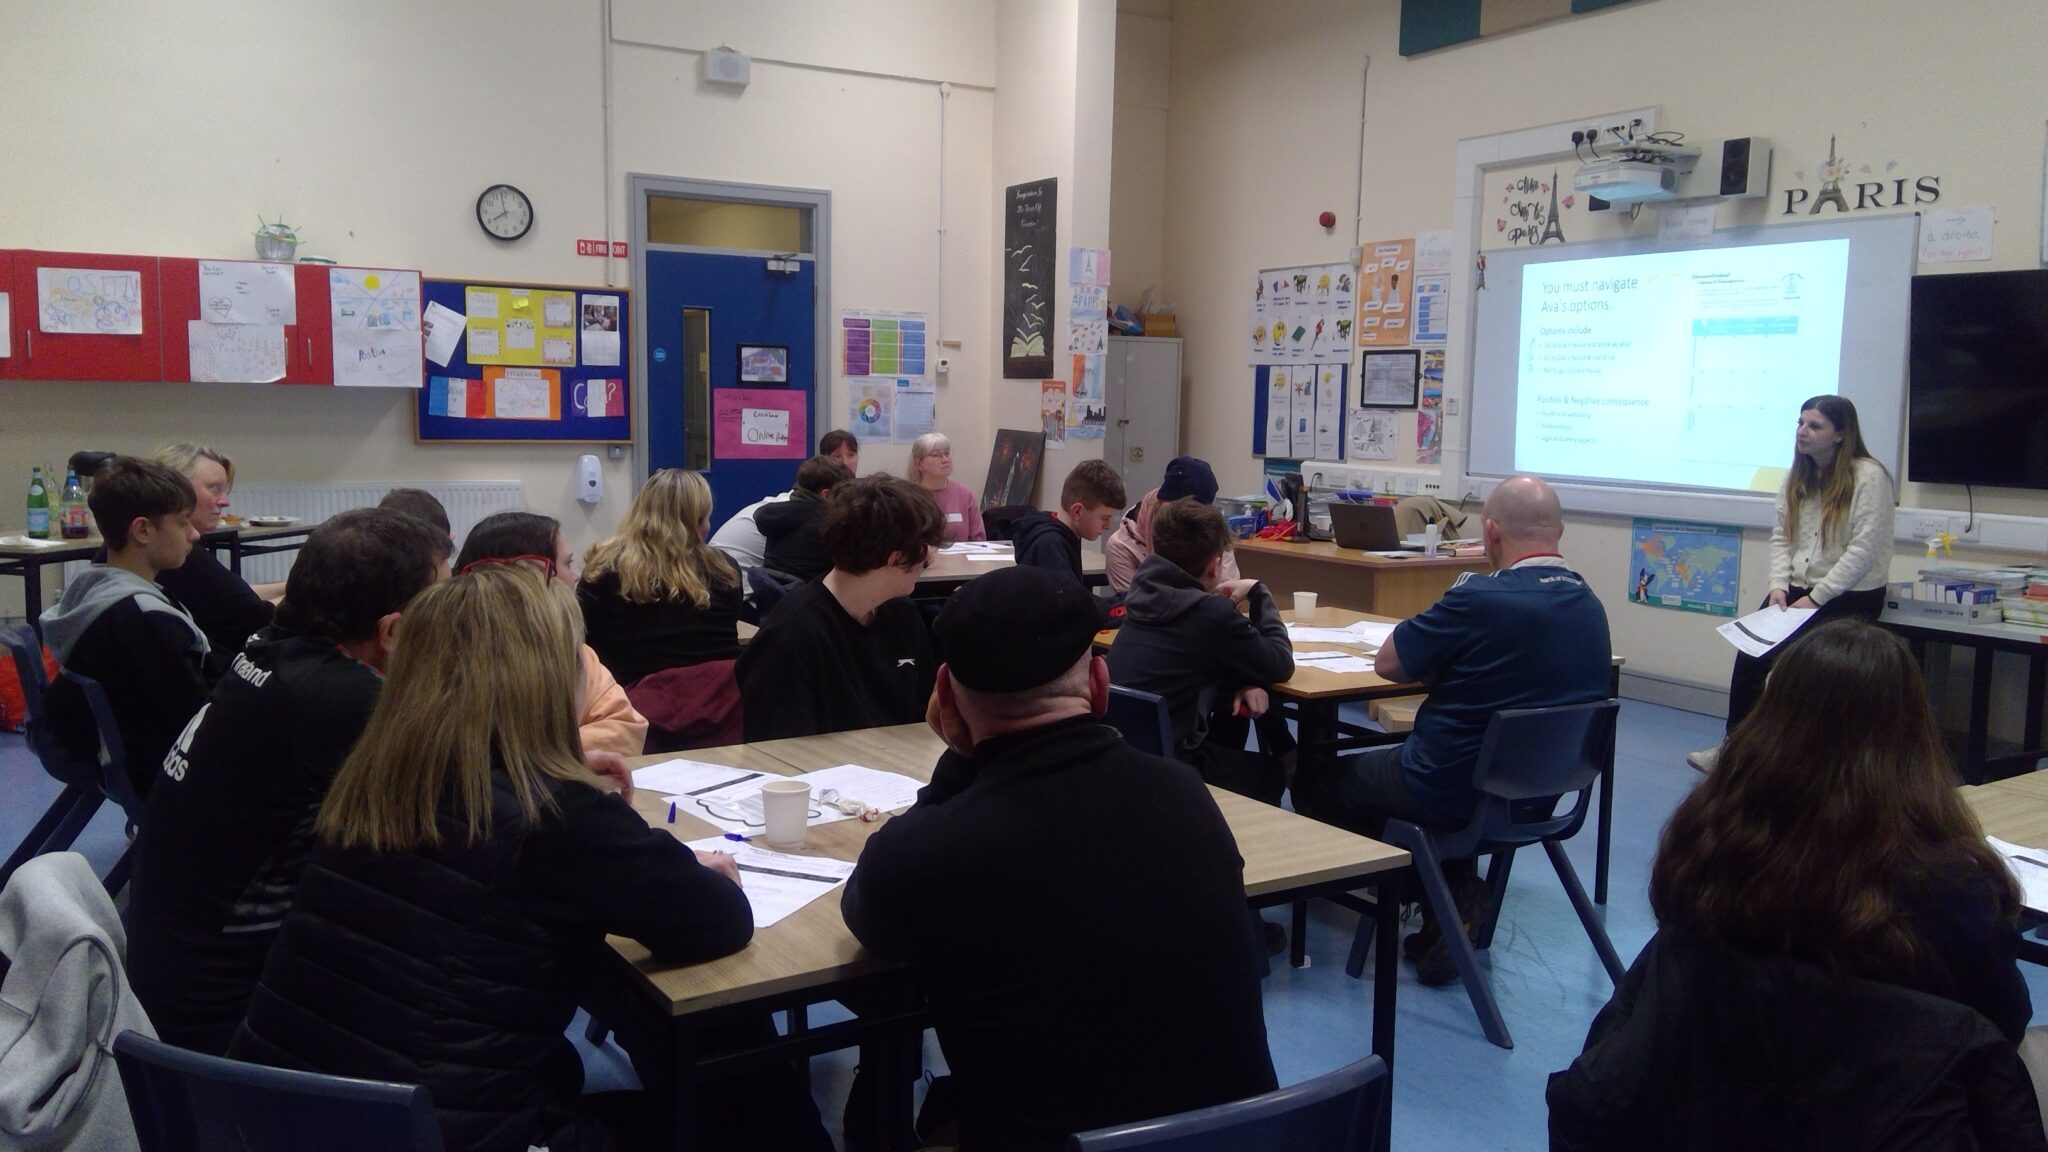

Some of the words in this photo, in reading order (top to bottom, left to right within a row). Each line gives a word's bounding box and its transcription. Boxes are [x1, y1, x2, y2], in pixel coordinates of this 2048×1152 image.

[1542, 280, 1560, 294] You
[1563, 280, 1589, 293] must
[1592, 277, 1638, 293] navigate
[1541, 300, 1567, 312] Ava's
